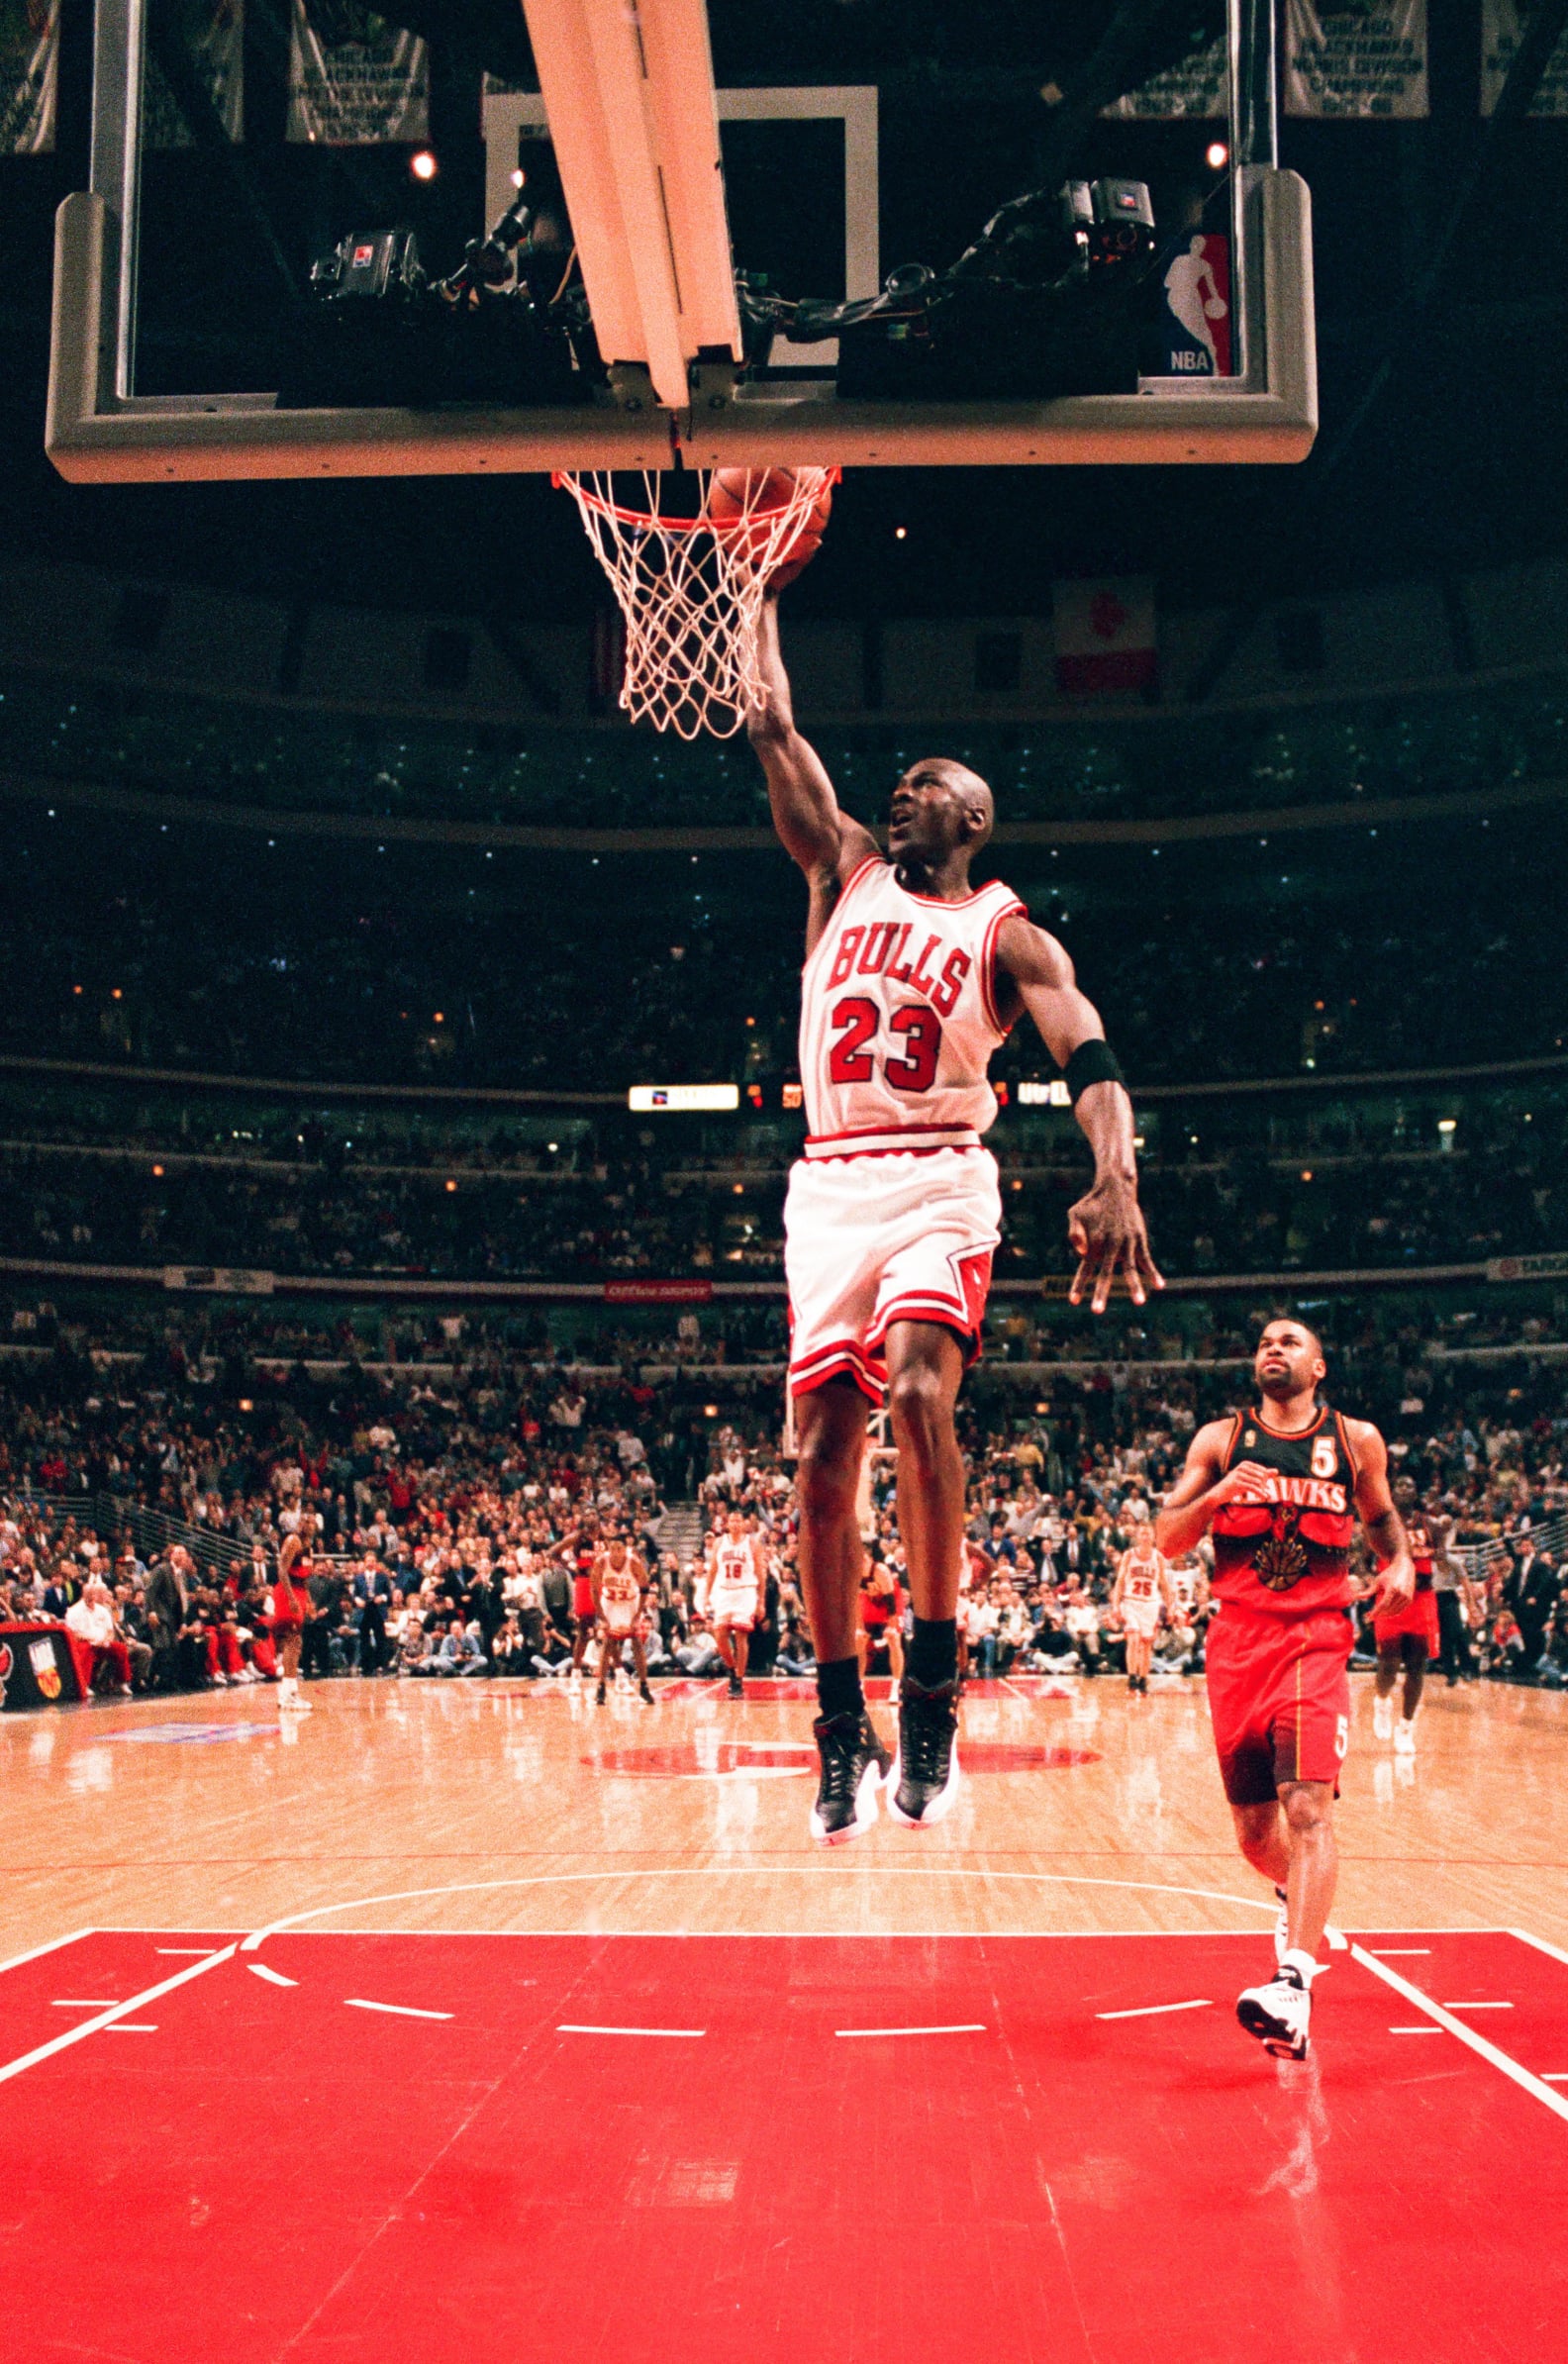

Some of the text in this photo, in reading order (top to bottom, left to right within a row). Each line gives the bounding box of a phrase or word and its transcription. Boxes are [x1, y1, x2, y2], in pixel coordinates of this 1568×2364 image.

[1171, 350, 1209, 370] NBA
[825, 922, 972, 1018] BULLS
[830, 996, 942, 1093] 23
[1312, 1436, 1337, 1478] 5
[1335, 1714, 1348, 1760] 5
